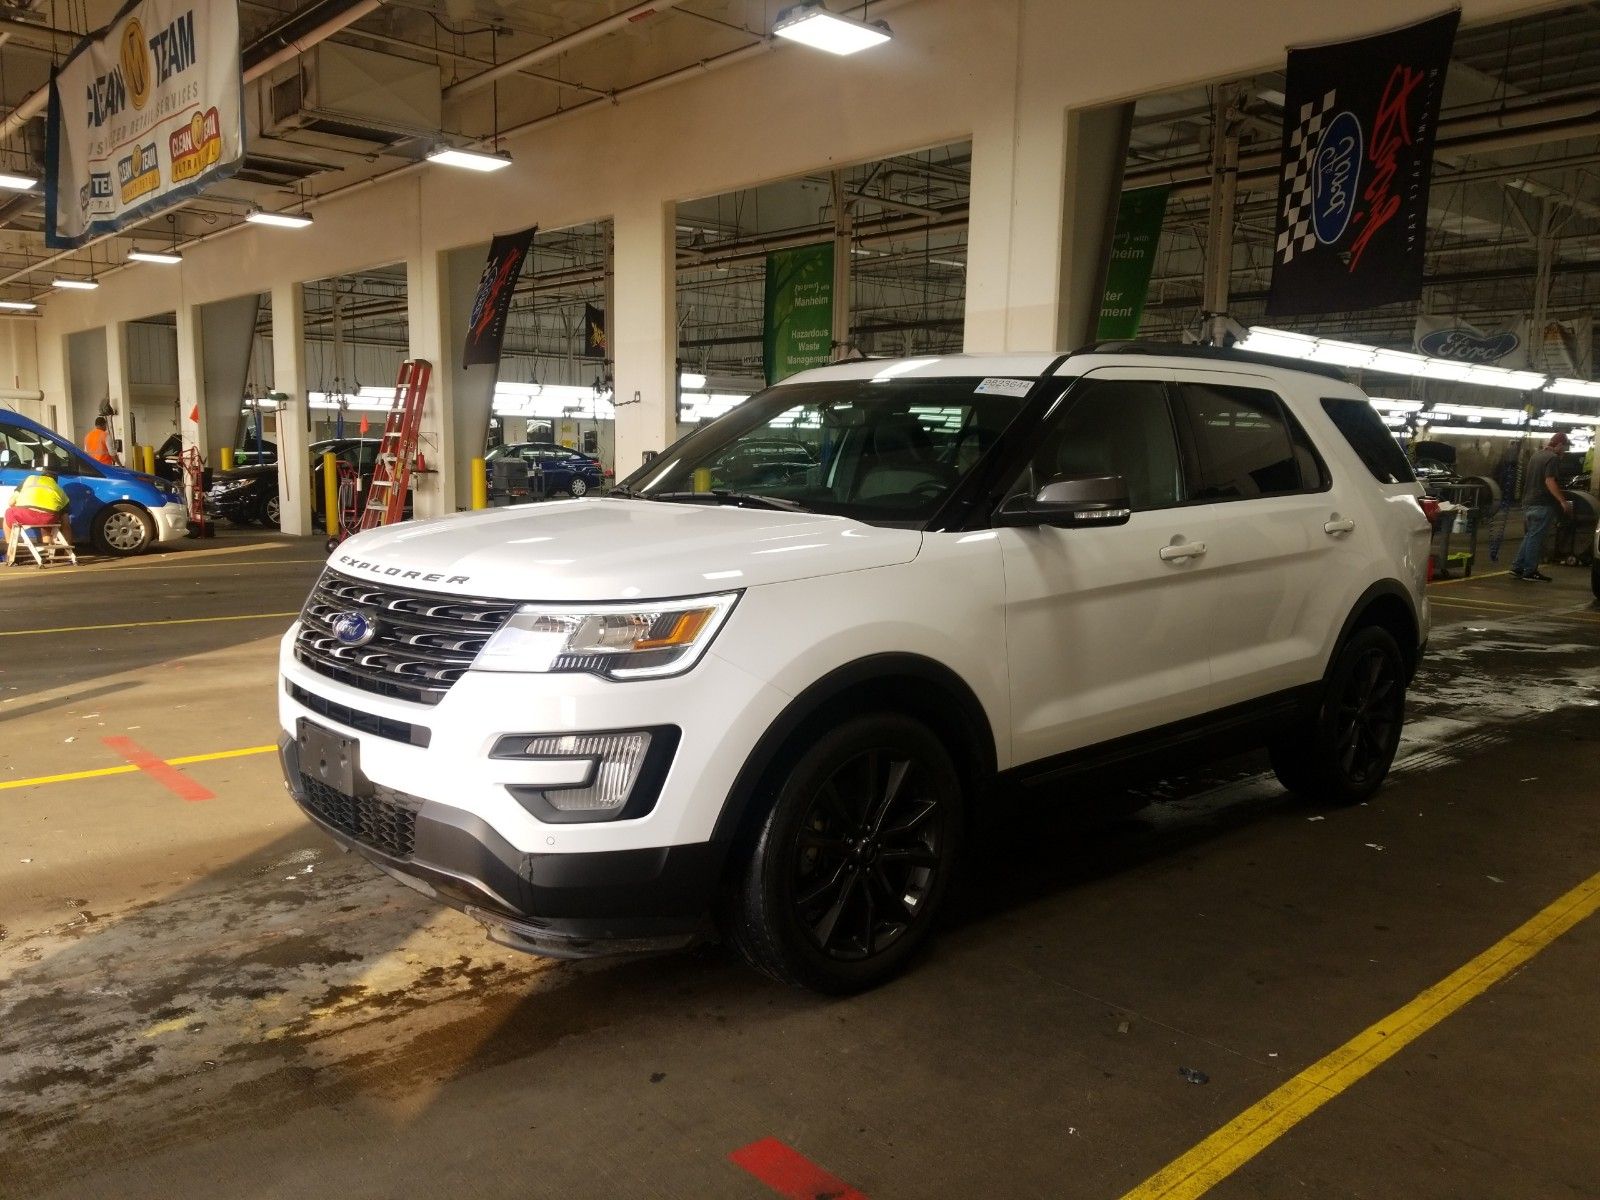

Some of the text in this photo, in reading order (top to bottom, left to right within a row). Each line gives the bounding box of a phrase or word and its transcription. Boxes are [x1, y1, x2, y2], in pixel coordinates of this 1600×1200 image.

[149, 9, 196, 88] TEAM
[156, 82, 199, 119] SERVICES
[1316, 136, 1355, 218] Ford
[794, 295, 828, 307] Manheim
[791, 328, 829, 339] Hazardous
[798, 341, 820, 351] Waste
[1437, 331, 1504, 361] Ford
[339, 555, 470, 585] EXPLORER
